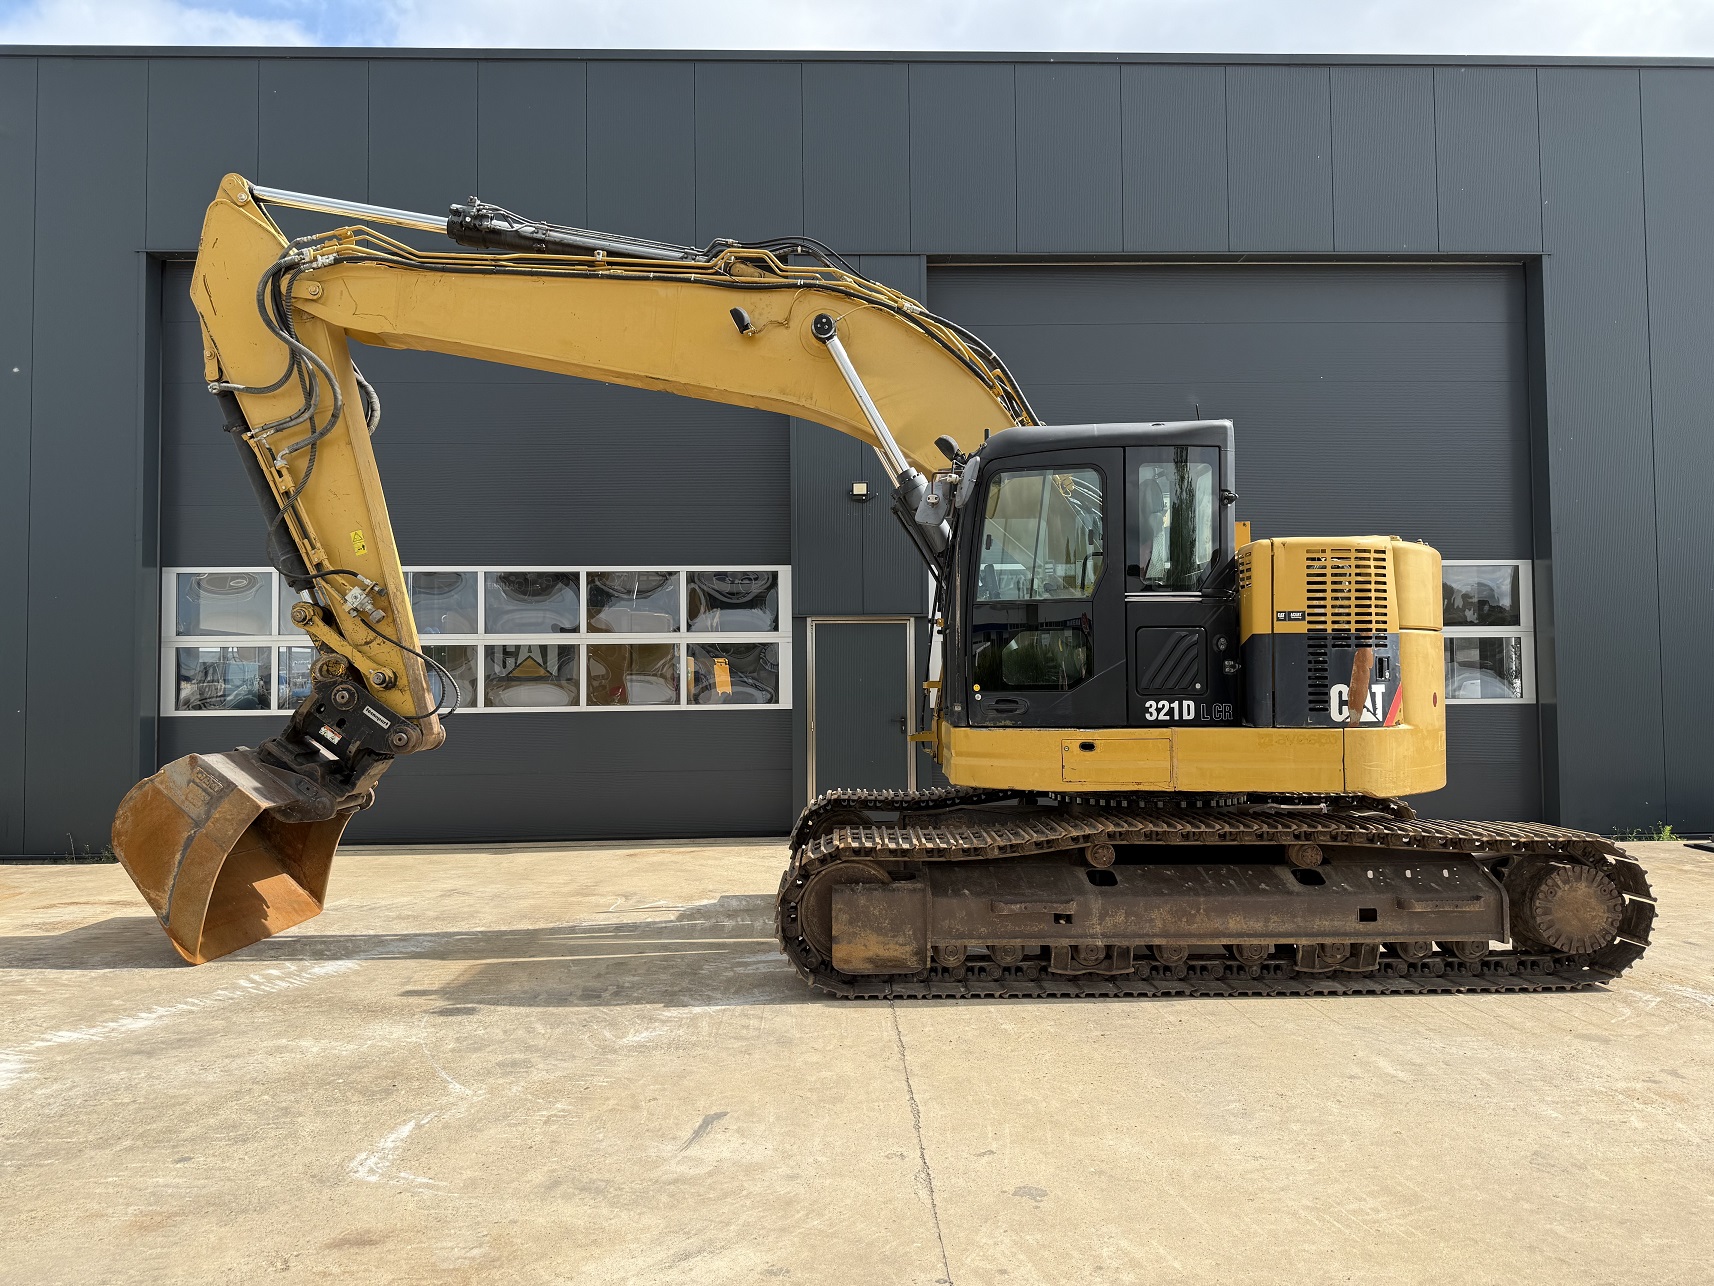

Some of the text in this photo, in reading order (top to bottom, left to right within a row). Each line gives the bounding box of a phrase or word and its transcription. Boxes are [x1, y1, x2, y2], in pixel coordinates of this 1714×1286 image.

[1145, 700, 1233, 720] 321D L CR
